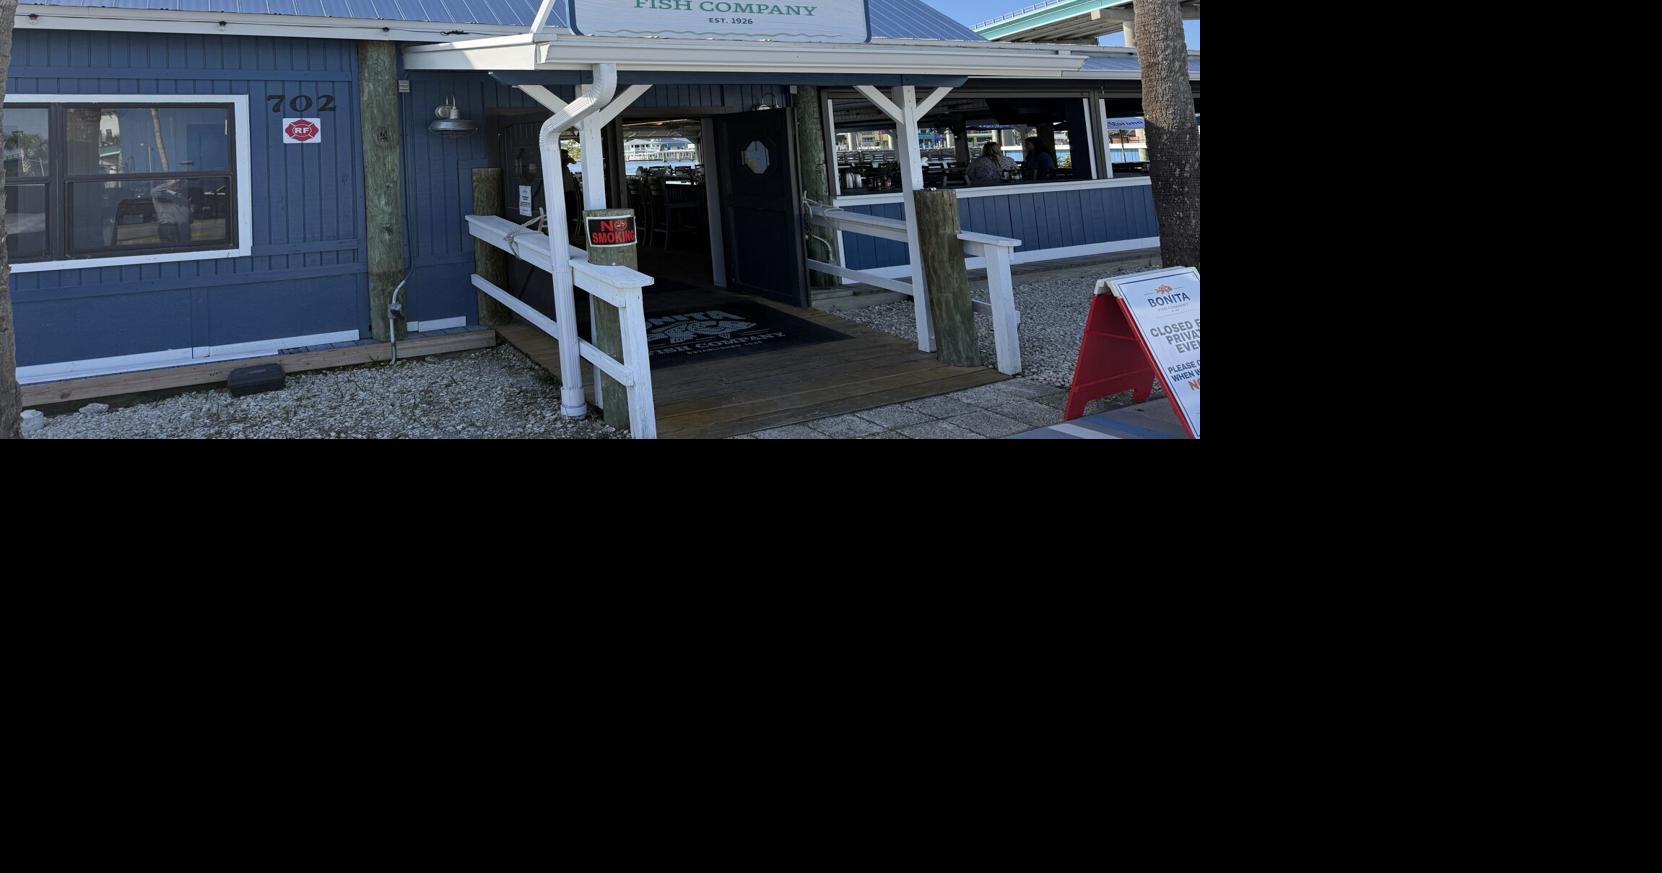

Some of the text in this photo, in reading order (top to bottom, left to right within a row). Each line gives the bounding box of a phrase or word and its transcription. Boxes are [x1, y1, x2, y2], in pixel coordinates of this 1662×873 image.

[633, 0, 818, 17] FISH COMPANY
[731, 17, 754, 25] 1926
[265, 94, 337, 113] 702
[600, 220, 628, 231] NO
[592, 230, 635, 244] SMOKING
[1147, 292, 1191, 308] BONITA
[1149, 320, 1194, 338] CLOSED
[1167, 360, 1197, 374] PLEASE
[1171, 370, 1196, 382] WHEN
